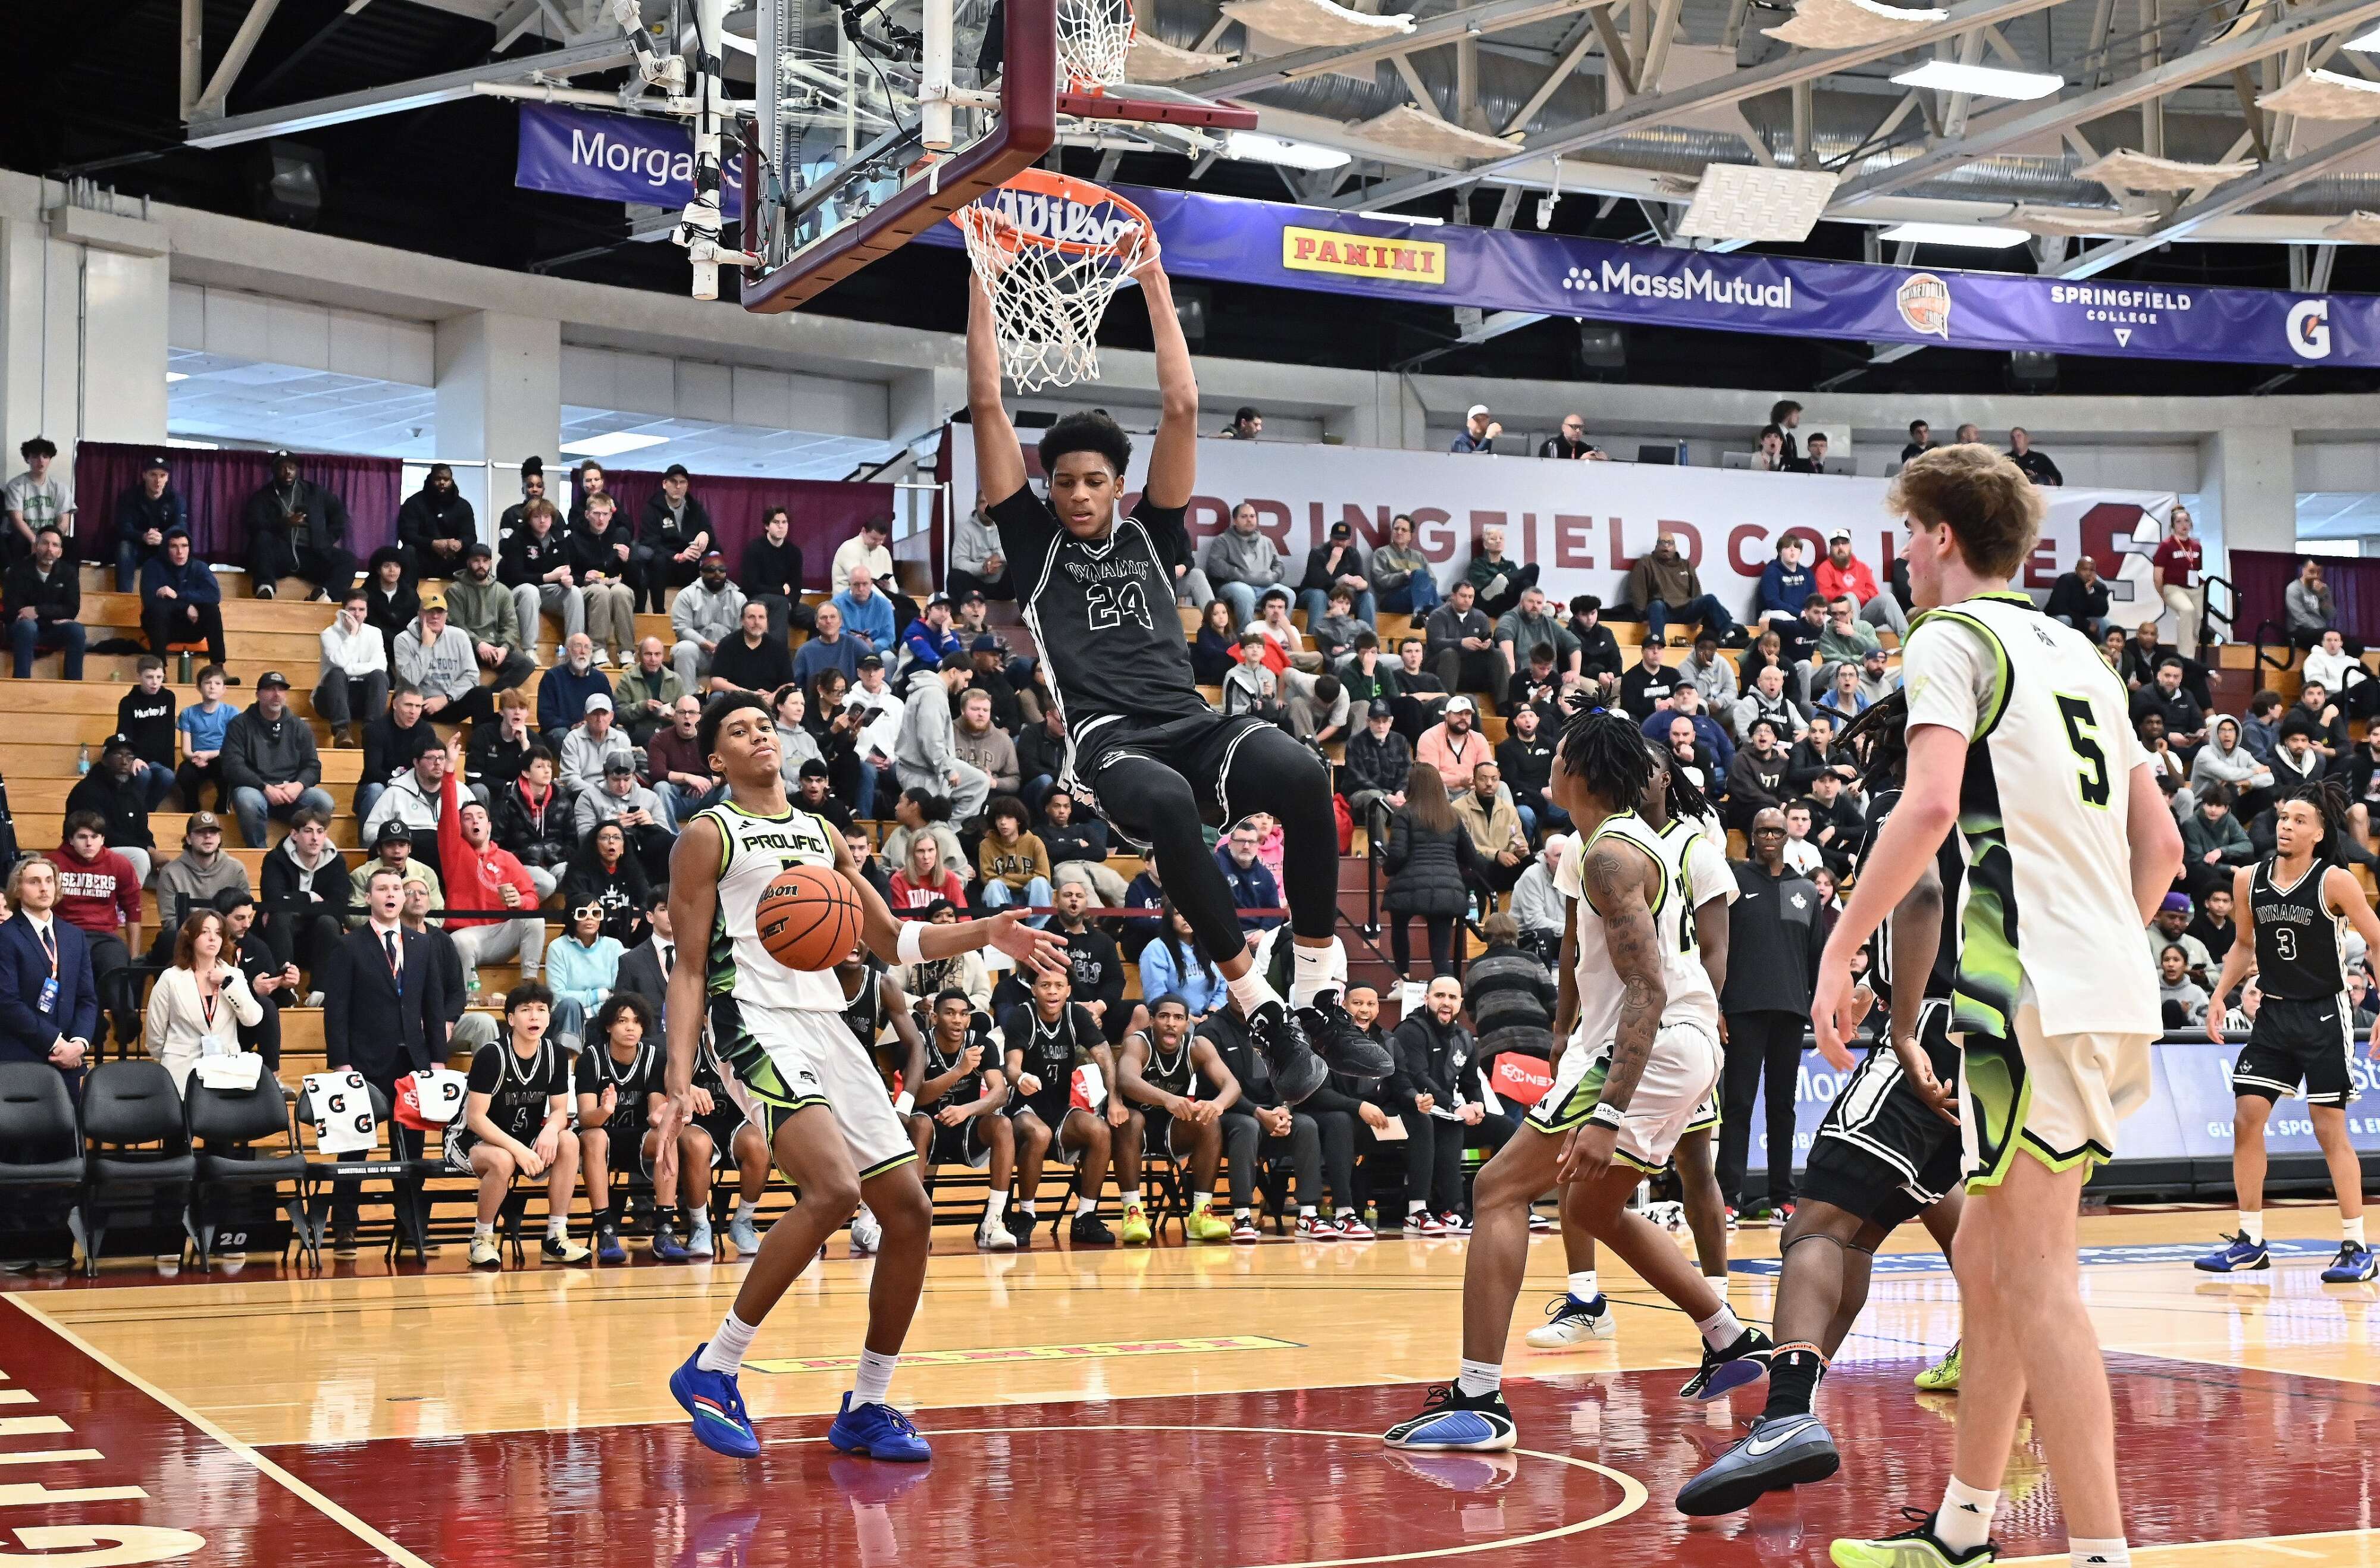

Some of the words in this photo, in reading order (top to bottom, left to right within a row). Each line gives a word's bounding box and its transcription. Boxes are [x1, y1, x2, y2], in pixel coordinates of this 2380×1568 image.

[572, 129, 694, 186] Morga
[1001, 191, 1141, 245] Wilso
[1294, 237, 1435, 274] PANINI
[1602, 260, 1792, 309] MassMutual
[2051, 286, 2191, 311] SPRINGFIELD
[2087, 309, 2157, 324] COLLEGE
[2285, 300, 2331, 359] G
[1086, 581, 1154, 631] 24
[2053, 691, 2110, 810] 5
[741, 834, 824, 854] PROLIFIC
[994, 854, 1034, 876] GAP
[2256, 904, 2313, 926] DYNAMIC
[2276, 928, 2297, 960] 3
[1795, 1065, 1848, 1102] Mor
[220, 1233, 248, 1246] 20
